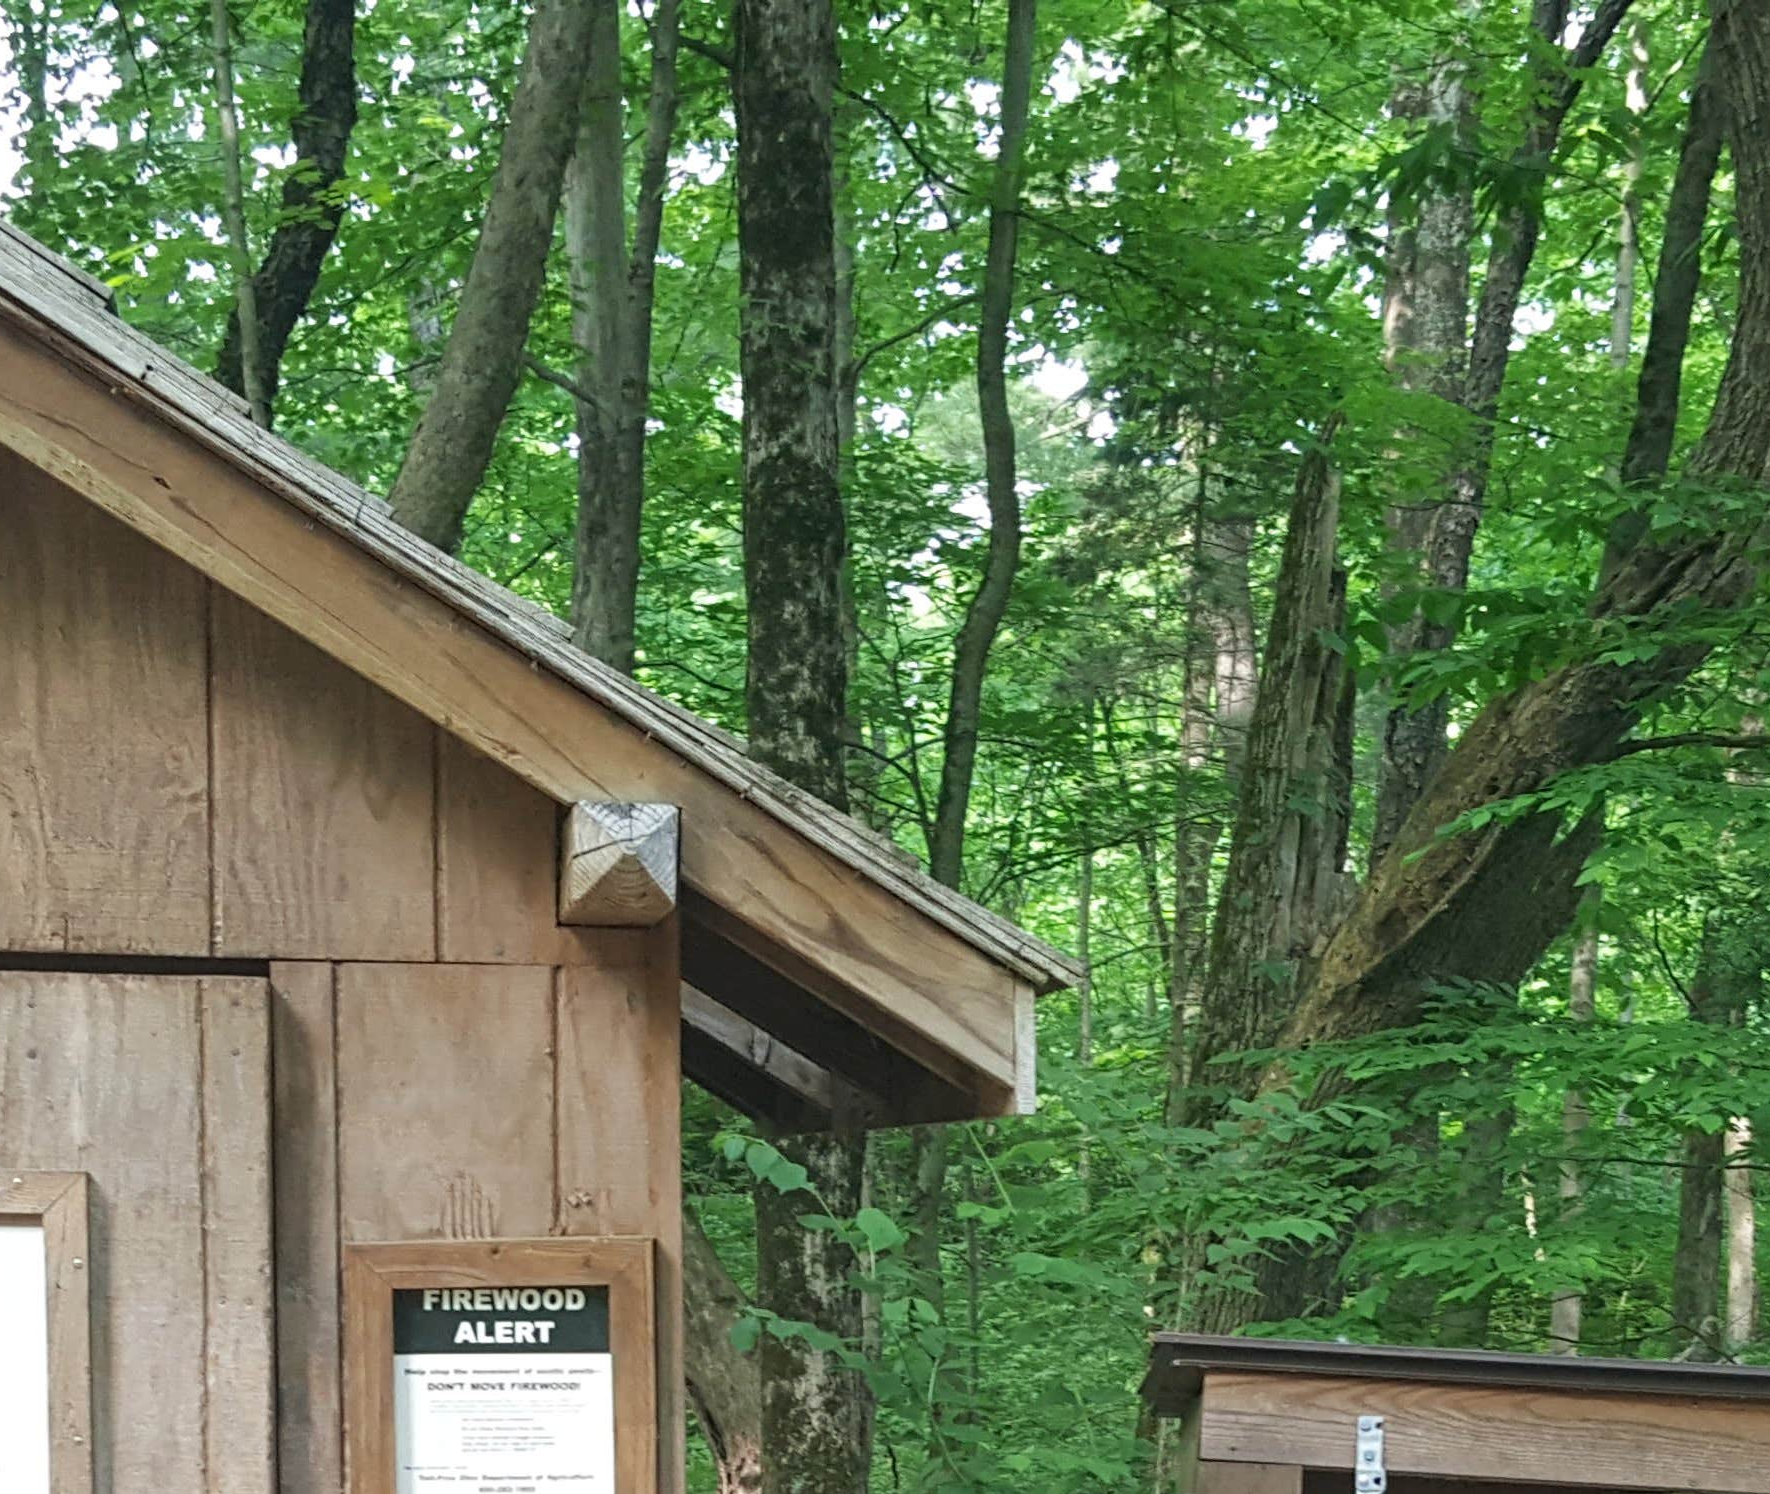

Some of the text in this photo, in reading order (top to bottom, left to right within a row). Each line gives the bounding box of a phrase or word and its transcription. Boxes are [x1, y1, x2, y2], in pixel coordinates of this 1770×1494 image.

[422, 1288, 587, 1312] FIREWOOD
[453, 1321, 556, 1344] ALERT
[470, 1382, 505, 1391] MOVE
